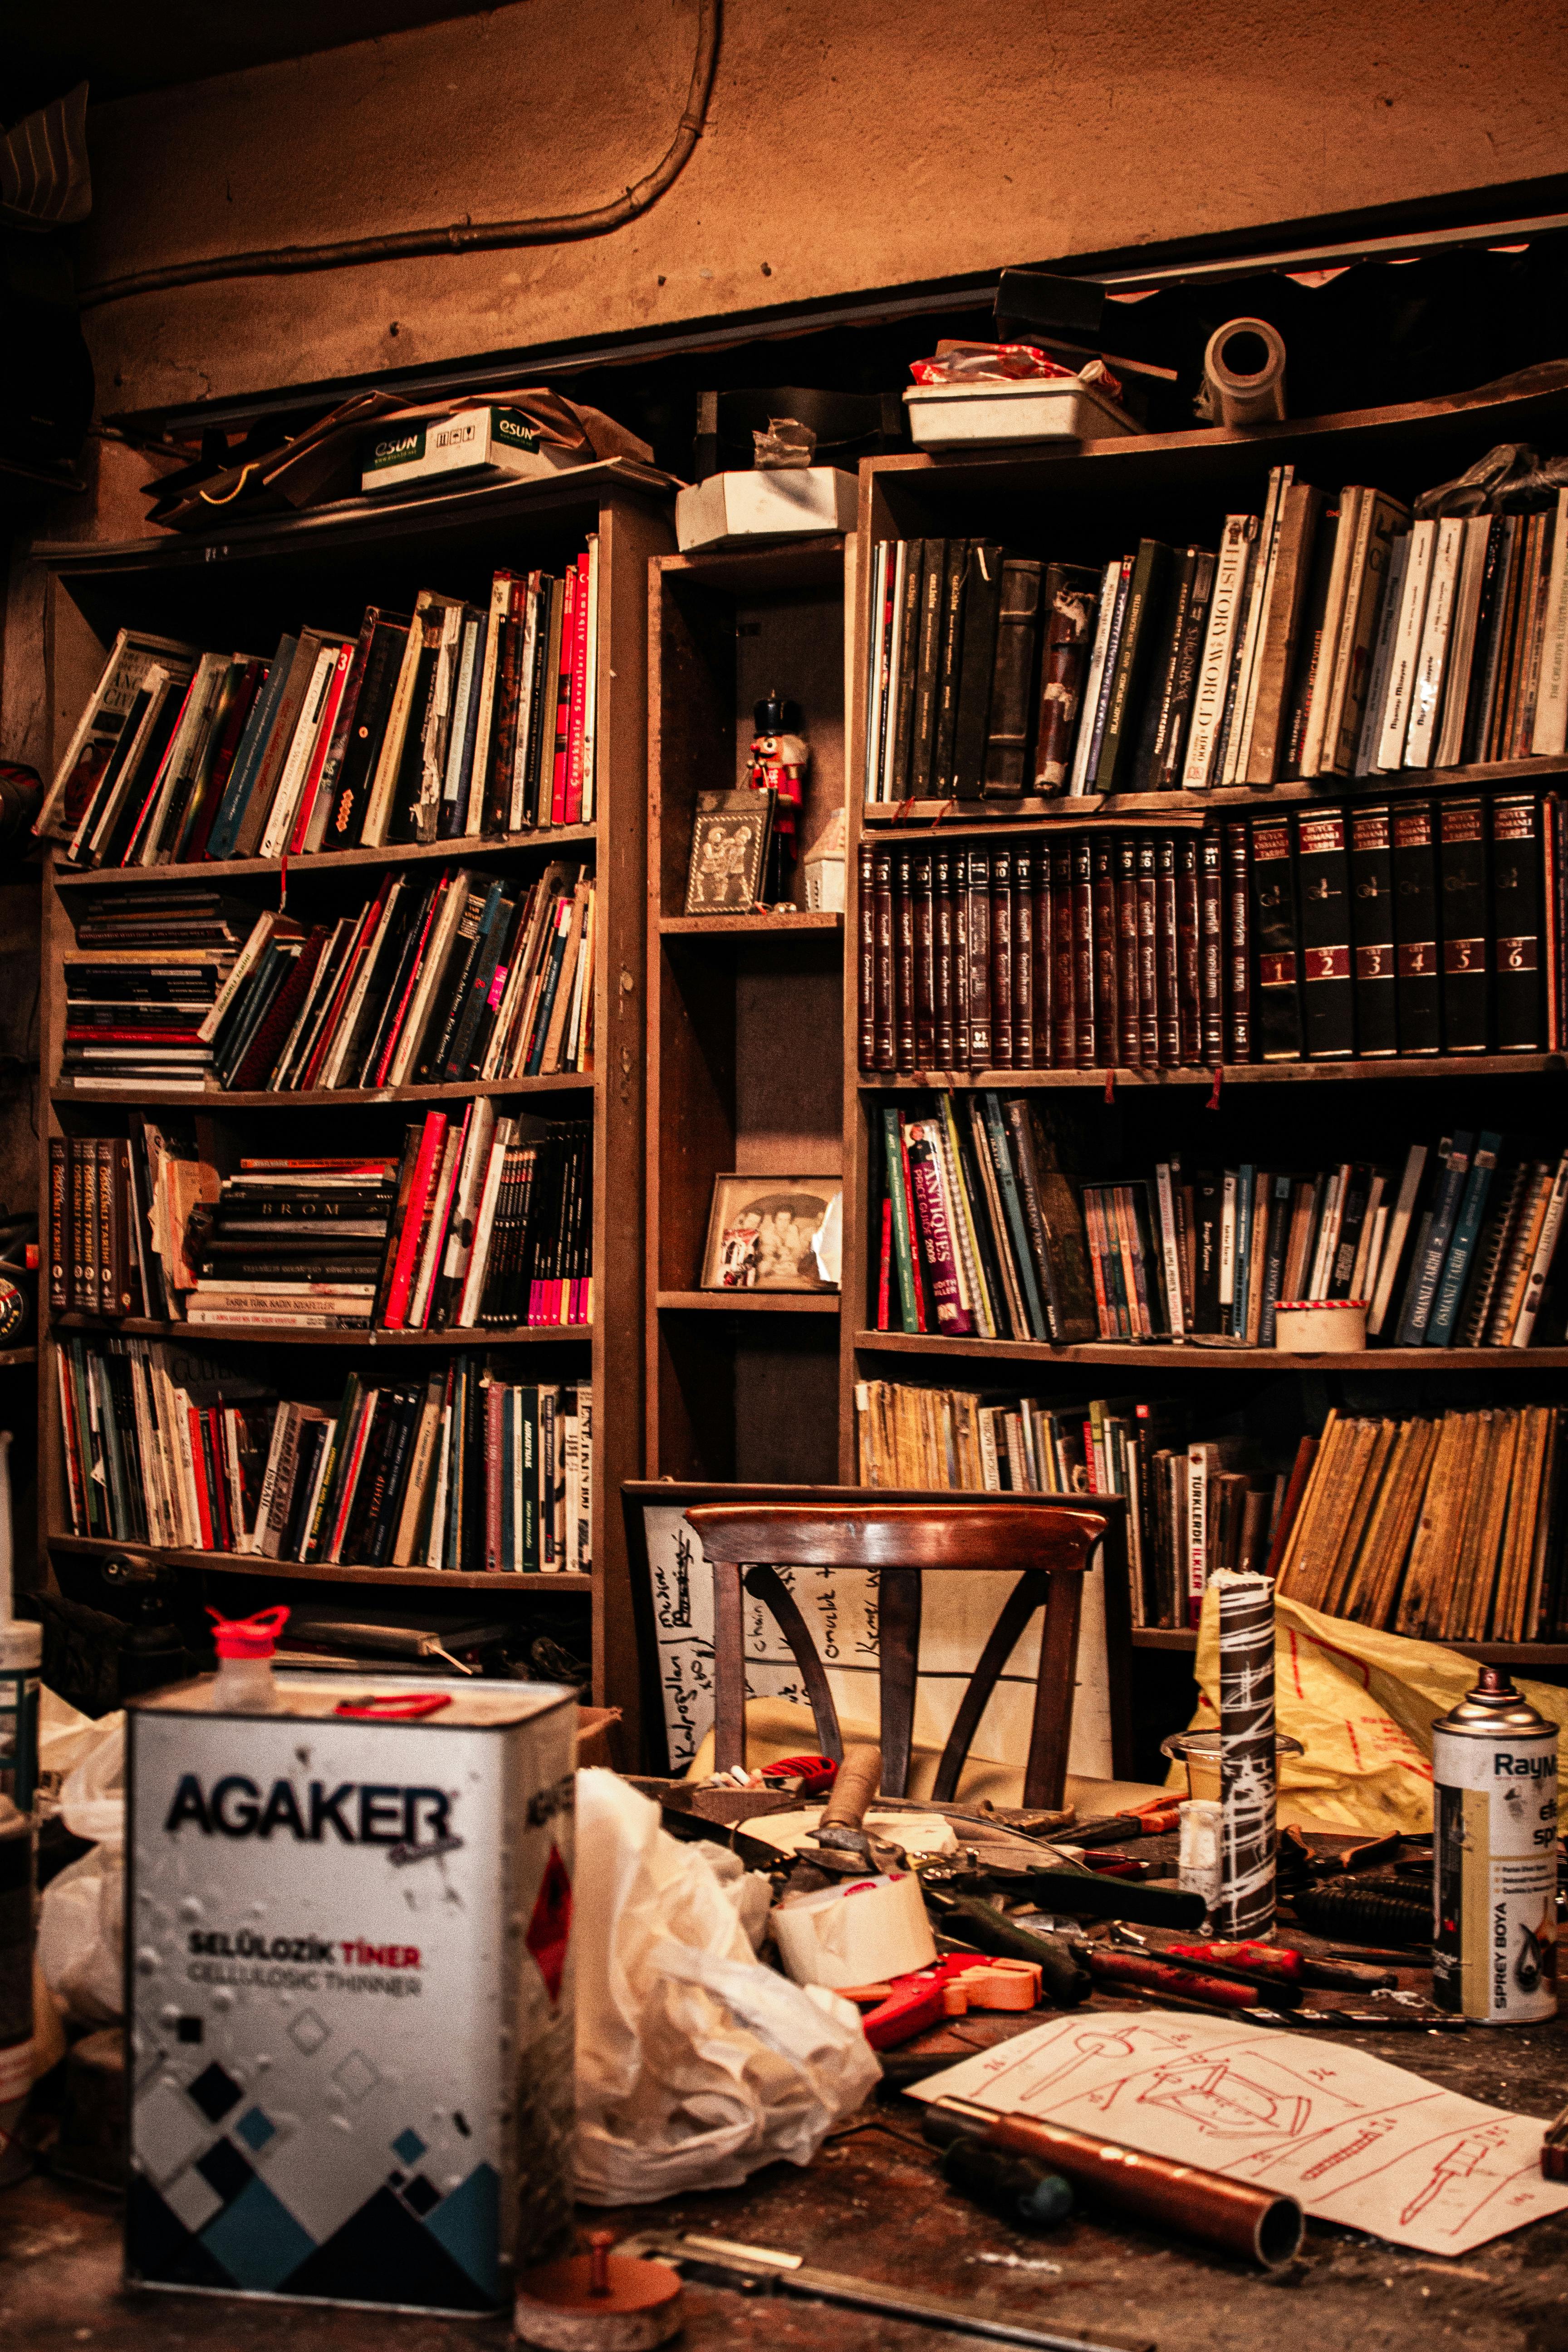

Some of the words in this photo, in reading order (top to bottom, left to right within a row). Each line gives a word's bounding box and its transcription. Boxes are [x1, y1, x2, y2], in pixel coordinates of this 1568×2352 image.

[1212, 548, 1240, 639] HISTORY
[570, 719, 581, 785] Çanakkale
[578, 592, 587, 640] Albümü
[1115, 672, 1127, 703] SWORDS
[1122, 651, 1131, 668] AND
[1197, 647, 1224, 727] WORLD
[1550, 682, 1558, 698] THE
[1196, 734, 1208, 761] 1000
[1275, 963, 1283, 980] 1
[1322, 957, 1333, 975] 2
[1368, 956, 1381, 975] 3
[1411, 954, 1424, 971] 4
[1457, 950, 1471, 968] 5
[1509, 948, 1523, 967] 6
[458, 980, 466, 993] Art
[53, 1164, 61, 1216] OSMANLI
[83, 1165, 92, 1217] OSMANLI
[99, 1166, 108, 1220] OSMANLI
[912, 1169, 926, 1200] PRICE
[262, 1203, 339, 1215] BROM
[920, 1166, 952, 1263] ANTIQUES
[53, 1220, 61, 1260] TARİHİ
[85, 1220, 93, 1262] TARİHİ
[101, 1223, 110, 1264] TARİHİ
[1264, 1256, 1280, 1301] KARATAY
[1420, 1249, 1442, 1282] TARİHİ
[1445, 1247, 1467, 1281] TARİHİ
[1410, 1284, 1434, 1328] OSMANLI
[1435, 1283, 1459, 1327] OSMANLI
[1192, 1475, 1203, 1544] TÜRKLERDE
[1194, 1548, 1204, 1589] İLKLER
[165, 1774, 451, 1845] AGAKER
[1494, 1902, 1507, 1948] BOYA
[341, 1935, 421, 1970] TİNER
[324, 1970, 422, 1996] THINNER
[1494, 1952, 1507, 2009] SPREY
